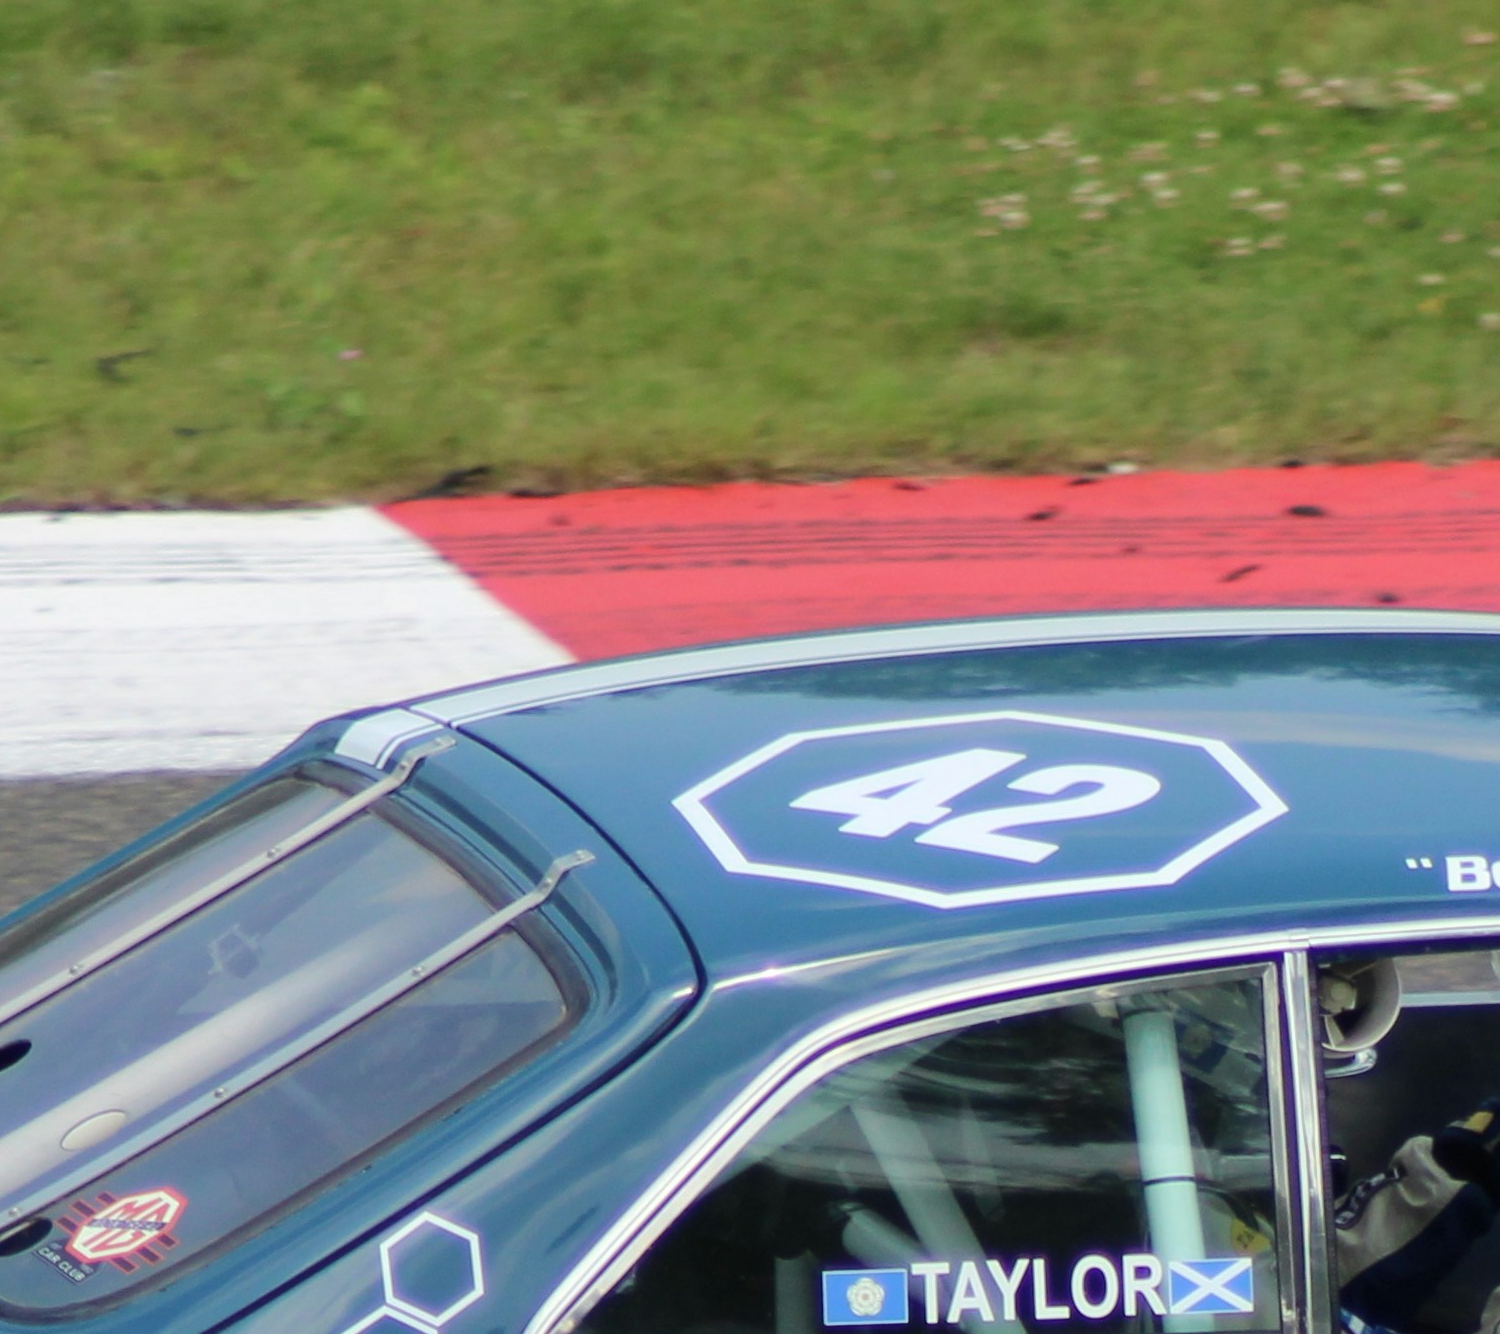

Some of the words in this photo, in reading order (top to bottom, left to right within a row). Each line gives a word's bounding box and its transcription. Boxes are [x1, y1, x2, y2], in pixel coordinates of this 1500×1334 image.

[789, 747, 1161, 864] 42
[38, 1247, 61, 1264] CAR
[911, 1254, 1168, 1324] TAYLOR
